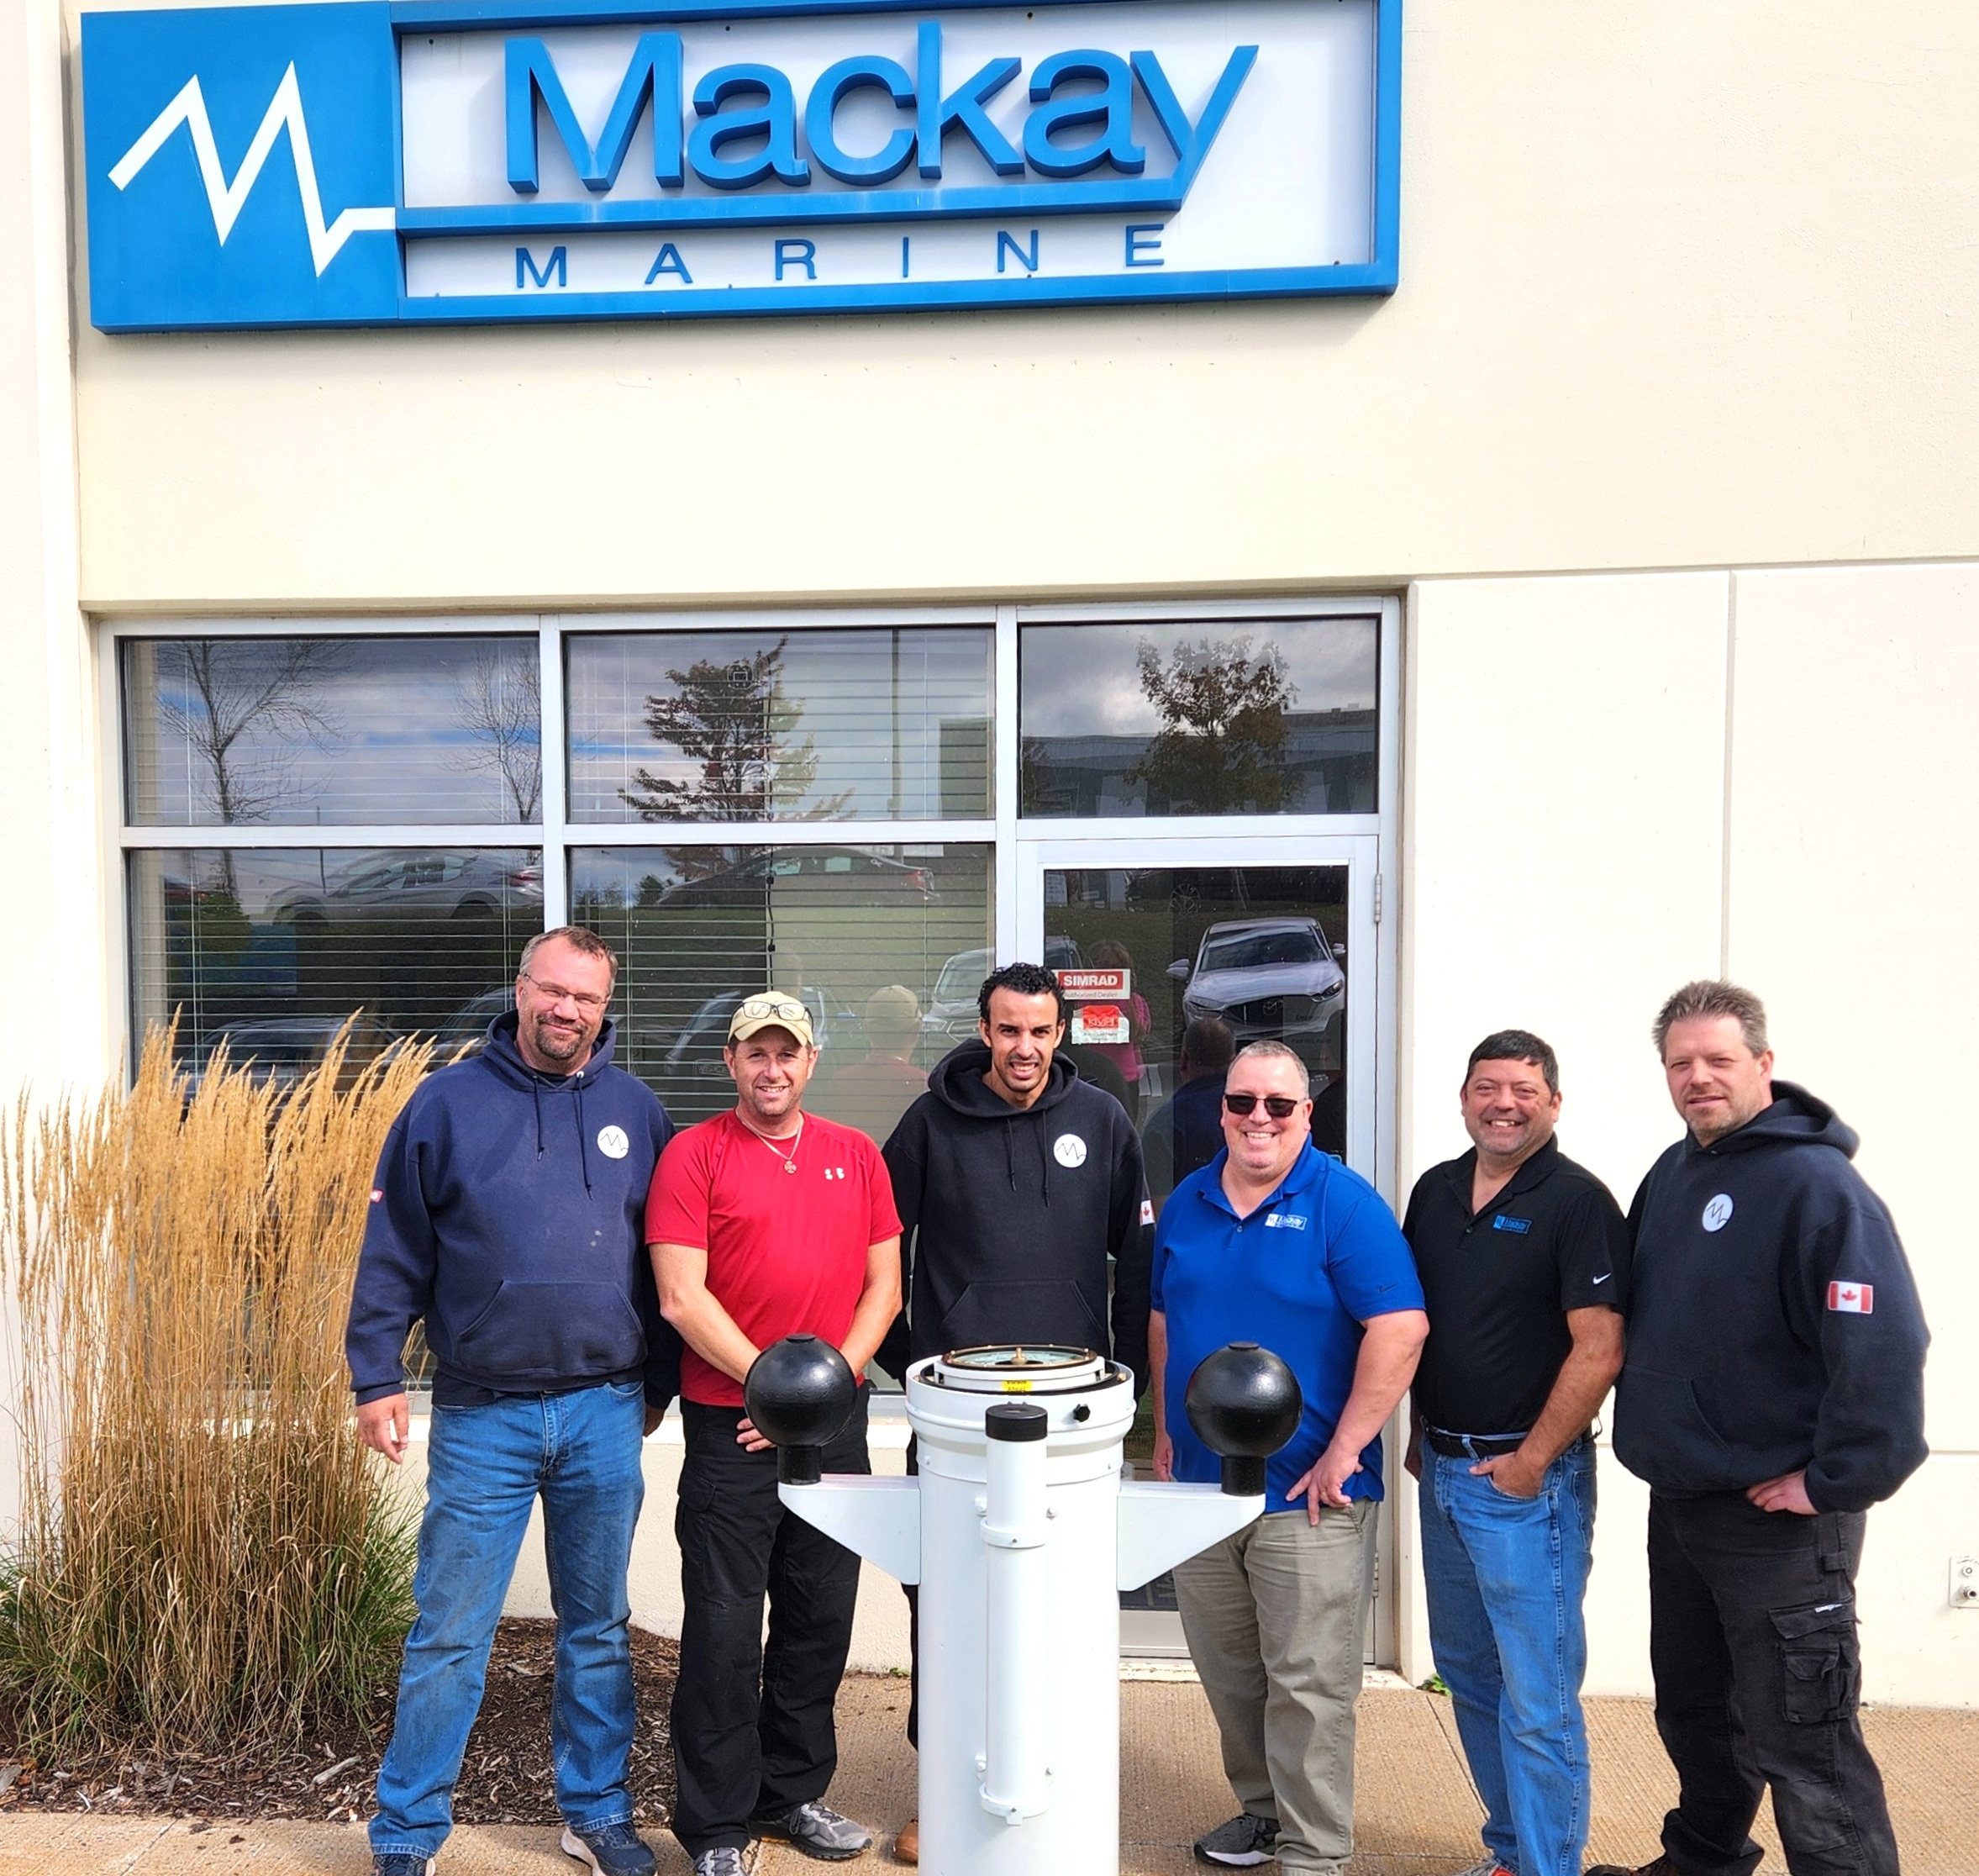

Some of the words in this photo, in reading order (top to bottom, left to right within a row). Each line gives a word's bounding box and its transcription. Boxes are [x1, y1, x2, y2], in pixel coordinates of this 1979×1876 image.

[504, 21, 1259, 210] Mackay
[515, 224, 1165, 288] MARINE
[1063, 975, 1118, 986] SIMRAD
